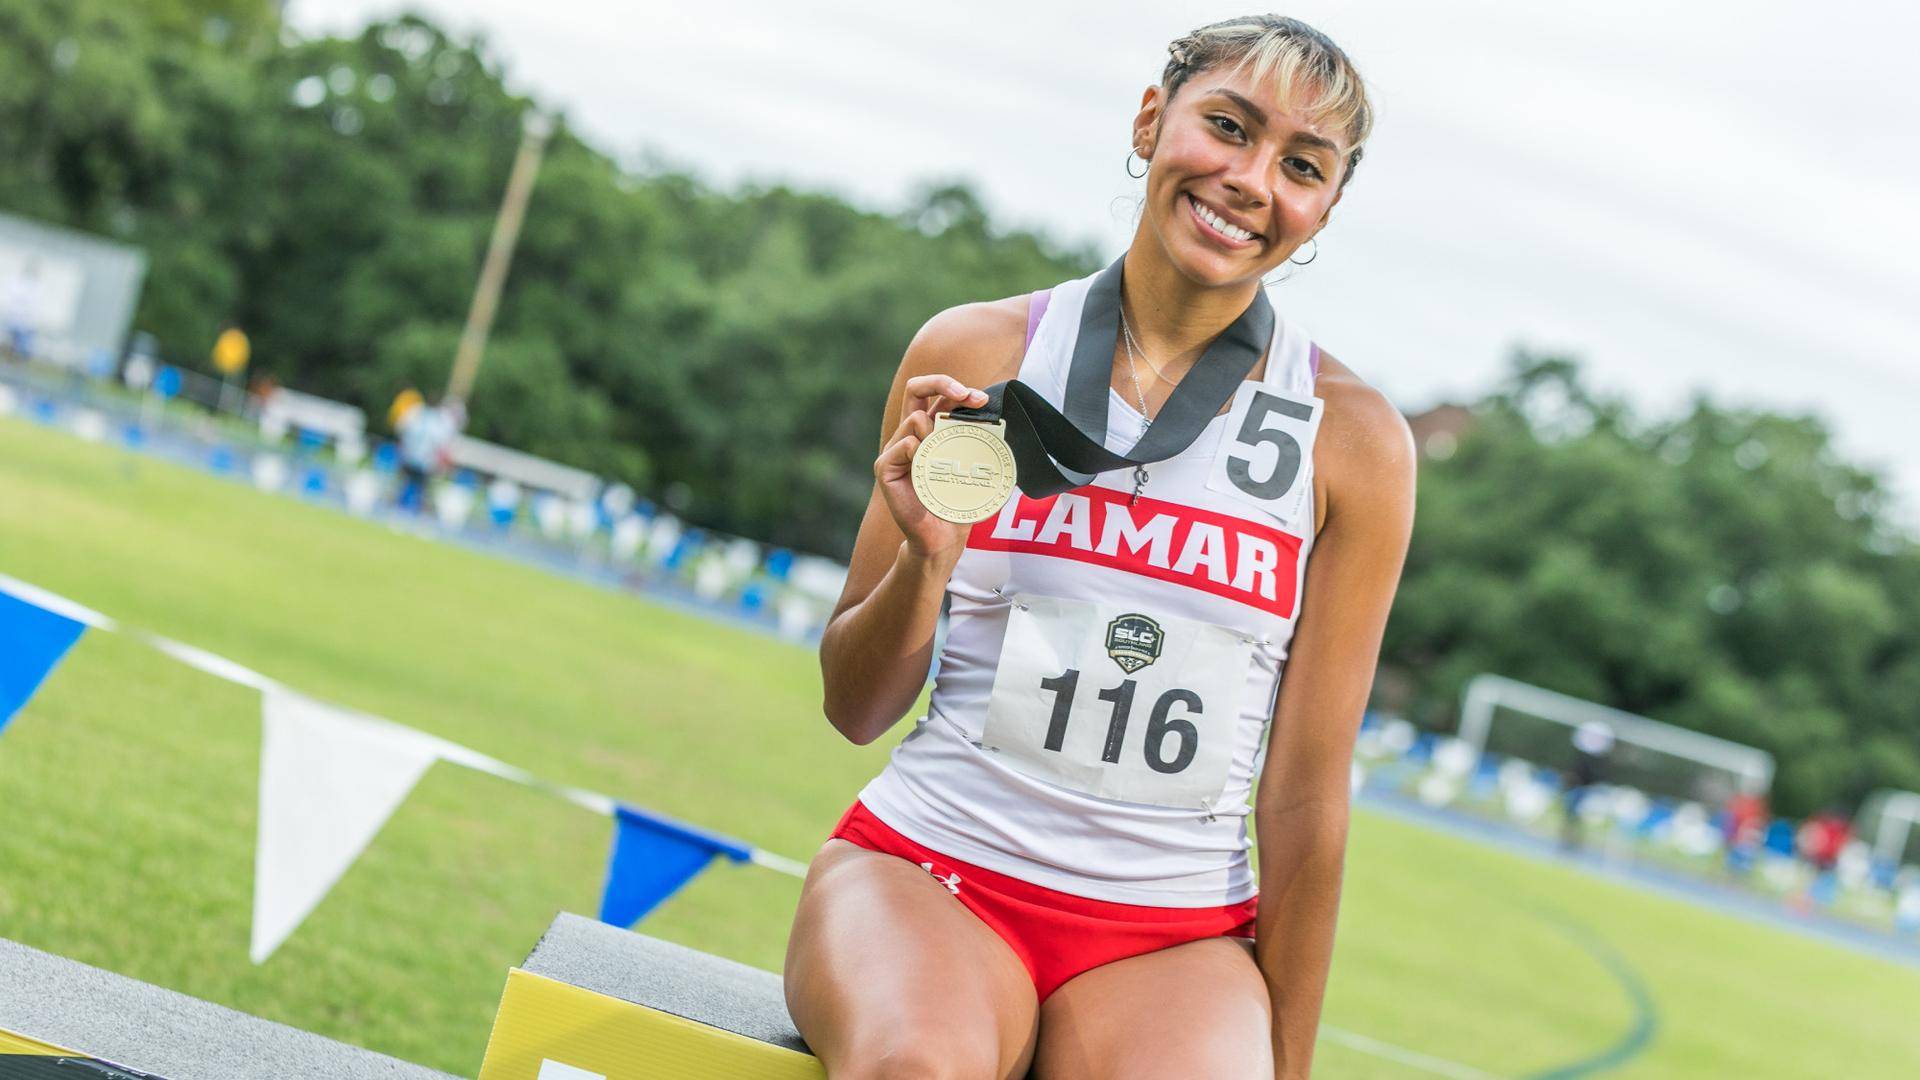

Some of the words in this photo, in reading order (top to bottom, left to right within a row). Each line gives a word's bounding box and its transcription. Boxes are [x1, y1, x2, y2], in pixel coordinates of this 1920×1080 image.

[1226, 390, 1314, 500] 5
[990, 485, 1278, 602] LAMAR
[1114, 627, 1153, 644] SLC
[1040, 668, 1203, 774] 116
